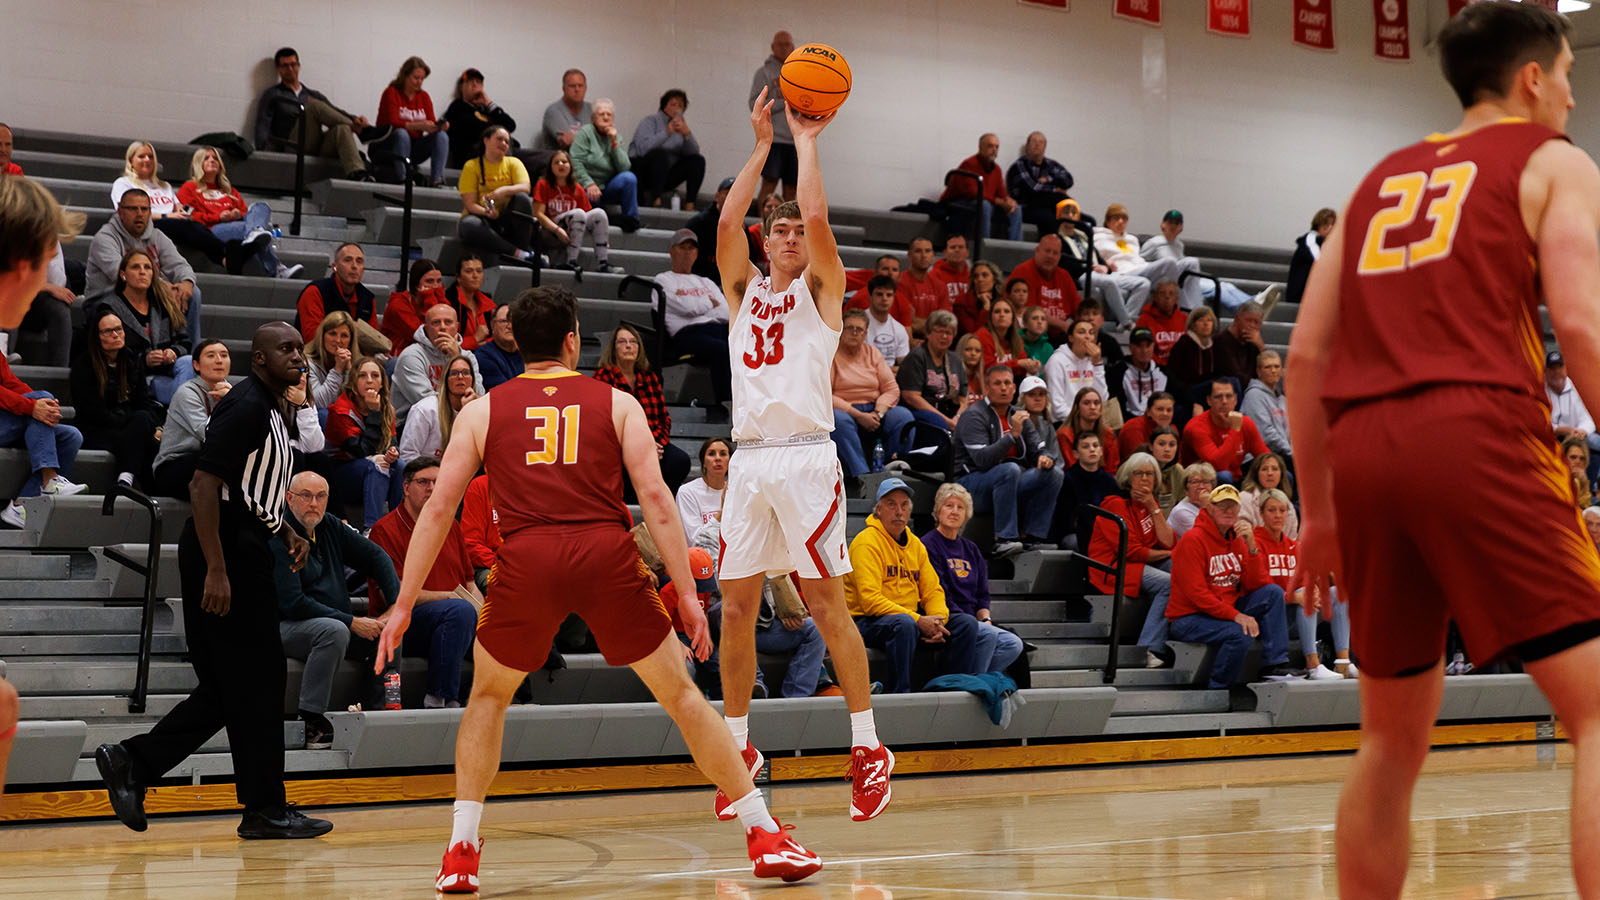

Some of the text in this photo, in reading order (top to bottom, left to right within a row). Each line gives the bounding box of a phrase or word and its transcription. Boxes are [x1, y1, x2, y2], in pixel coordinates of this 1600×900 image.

[802, 47, 836, 61] NCAA
[1357, 160, 1478, 275] 23
[743, 322, 785, 370] 33
[525, 404, 581, 466] 31
